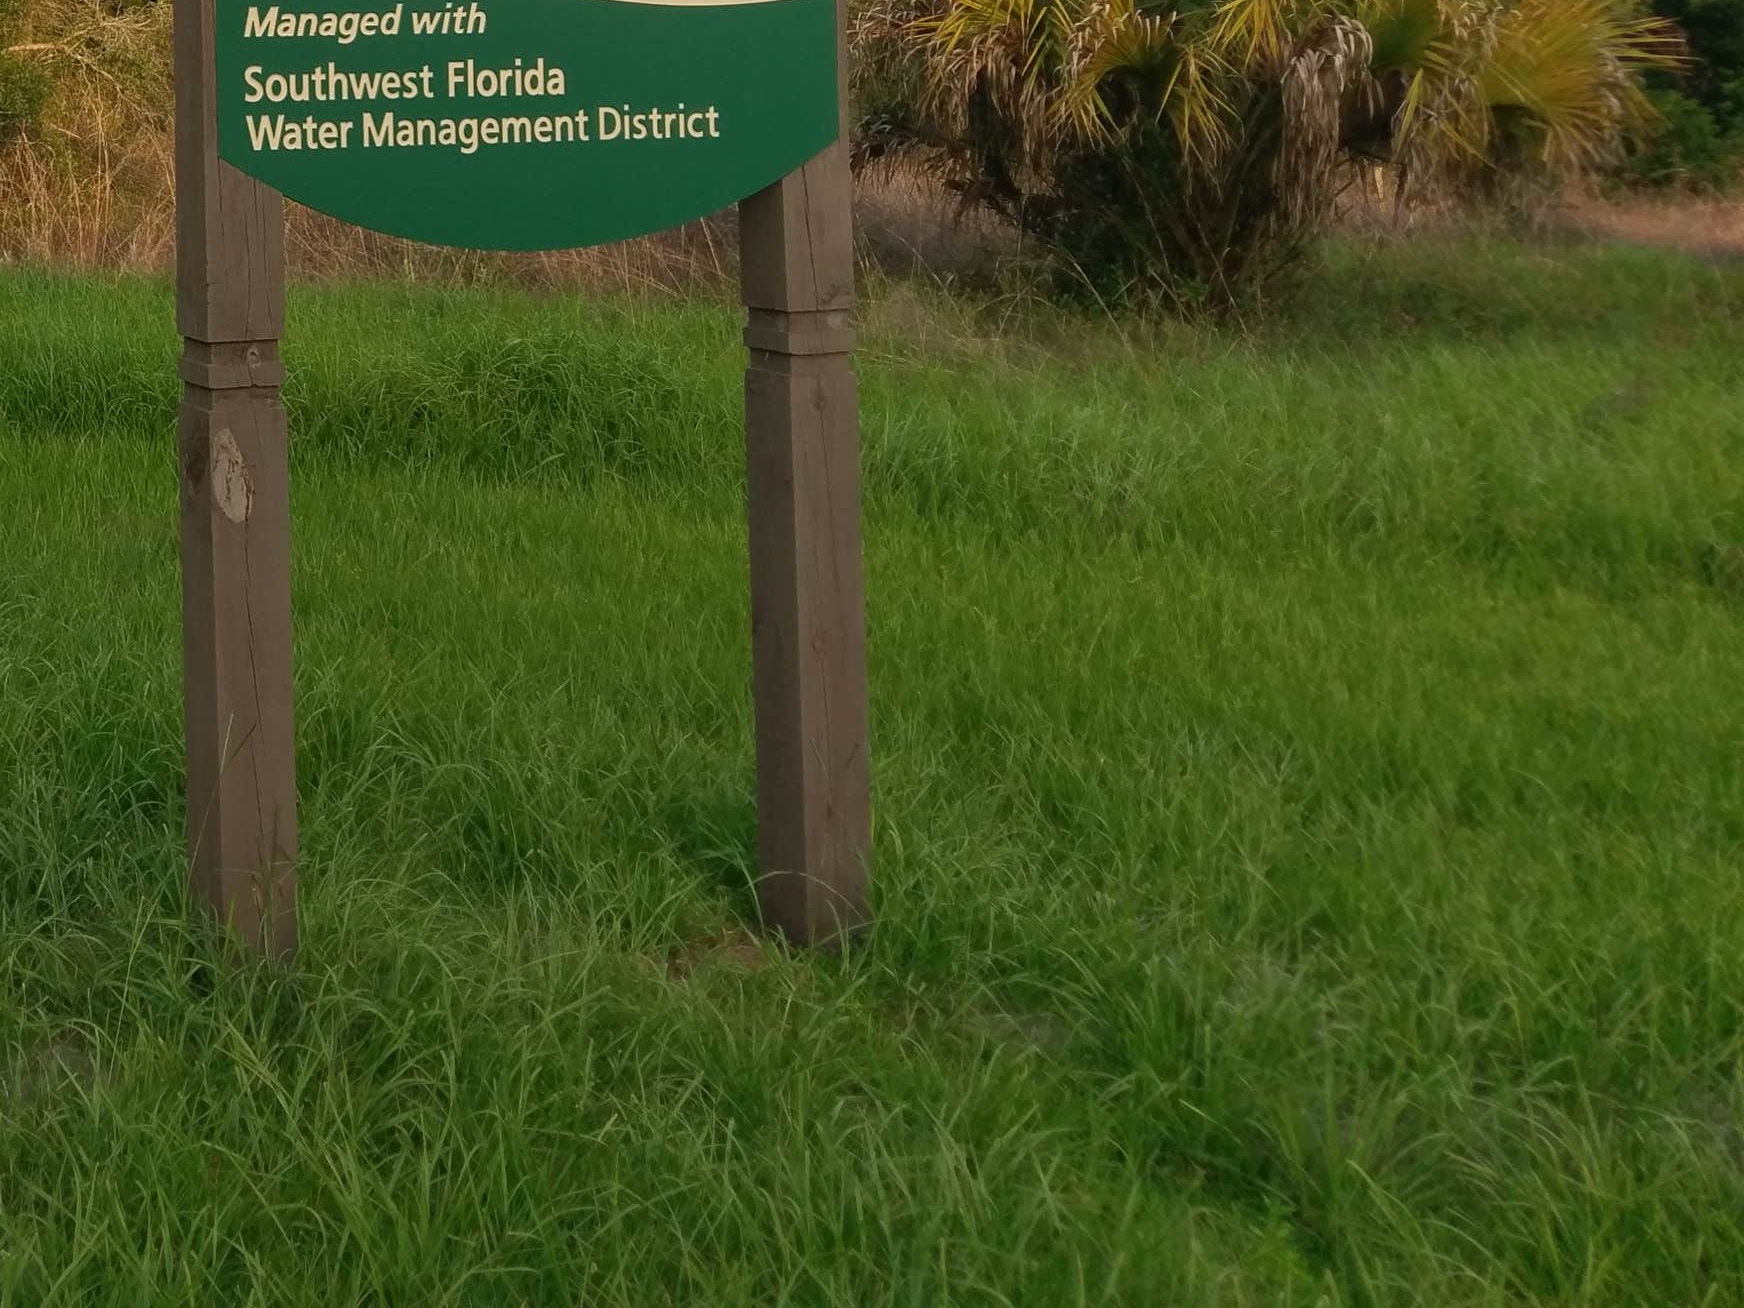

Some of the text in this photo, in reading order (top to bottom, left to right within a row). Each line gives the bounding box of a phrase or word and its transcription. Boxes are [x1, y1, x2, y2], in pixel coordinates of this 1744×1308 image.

[244, 3, 487, 43] Managed with
[244, 59, 565, 102] Southwest Florida
[247, 104, 719, 153] Water Management District
